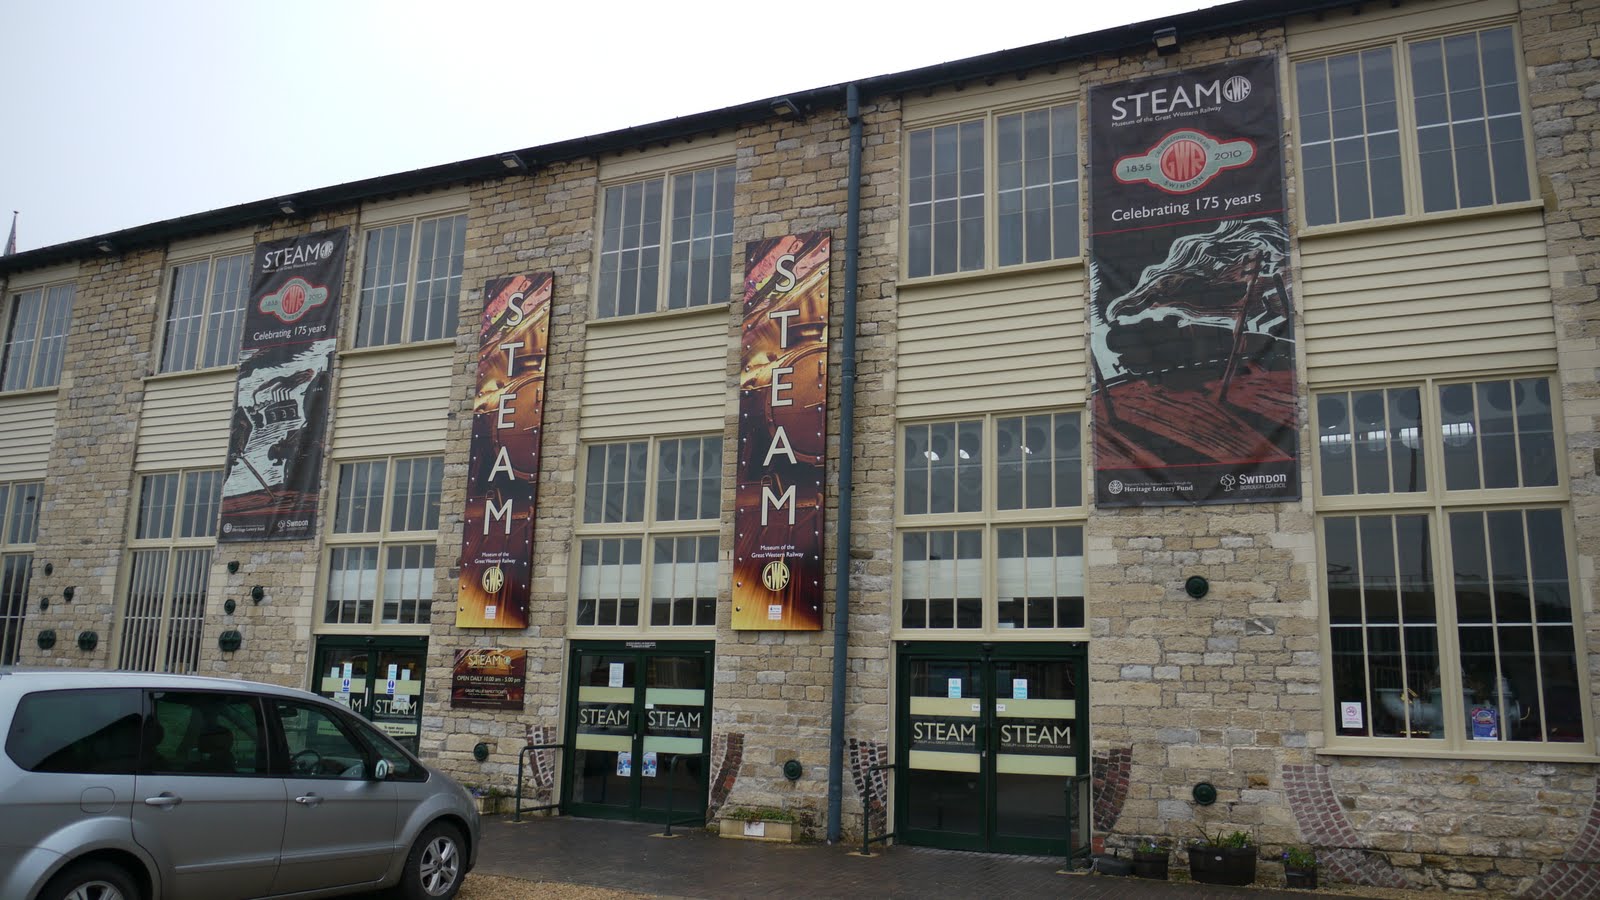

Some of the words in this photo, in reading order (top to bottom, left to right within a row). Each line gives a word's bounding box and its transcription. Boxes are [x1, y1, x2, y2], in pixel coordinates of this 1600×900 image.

[1111, 79, 1221, 121] STEAM
[1222, 76, 1251, 102] GWR
[1111, 120, 1135, 128] Museum
[1172, 110, 1199, 118] Western
[1200, 106, 1222, 114] Railway
[1161, 140, 1206, 181] GWR
[1214, 149, 1242, 161] 2010
[1126, 162, 1152, 174] 1835
[1164, 176, 1204, 189] SWINDON
[1111, 201, 1190, 222] Celebrating
[1196, 196, 1220, 211] 175
[1224, 193, 1262, 210] years
[262, 242, 321, 269] STEAM
[253, 328, 292, 341] Celebrating
[294, 325, 307, 336] 175
[308, 324, 327, 337] years
[760, 253, 799, 528] STEAM
[482, 291, 526, 537] STEAM
[1152, 485, 1175, 493] Lottery
[482, 566, 504, 593] GWR
[762, 561, 790, 591] GWR
[468, 654, 502, 666] STEAM
[375, 699, 417, 716] STEAM
[580, 708, 630, 725] STEAM
[648, 710, 701, 728] STEAM
[914, 722, 976, 742] STEAM
[1000, 724, 1071, 745] STEAM
